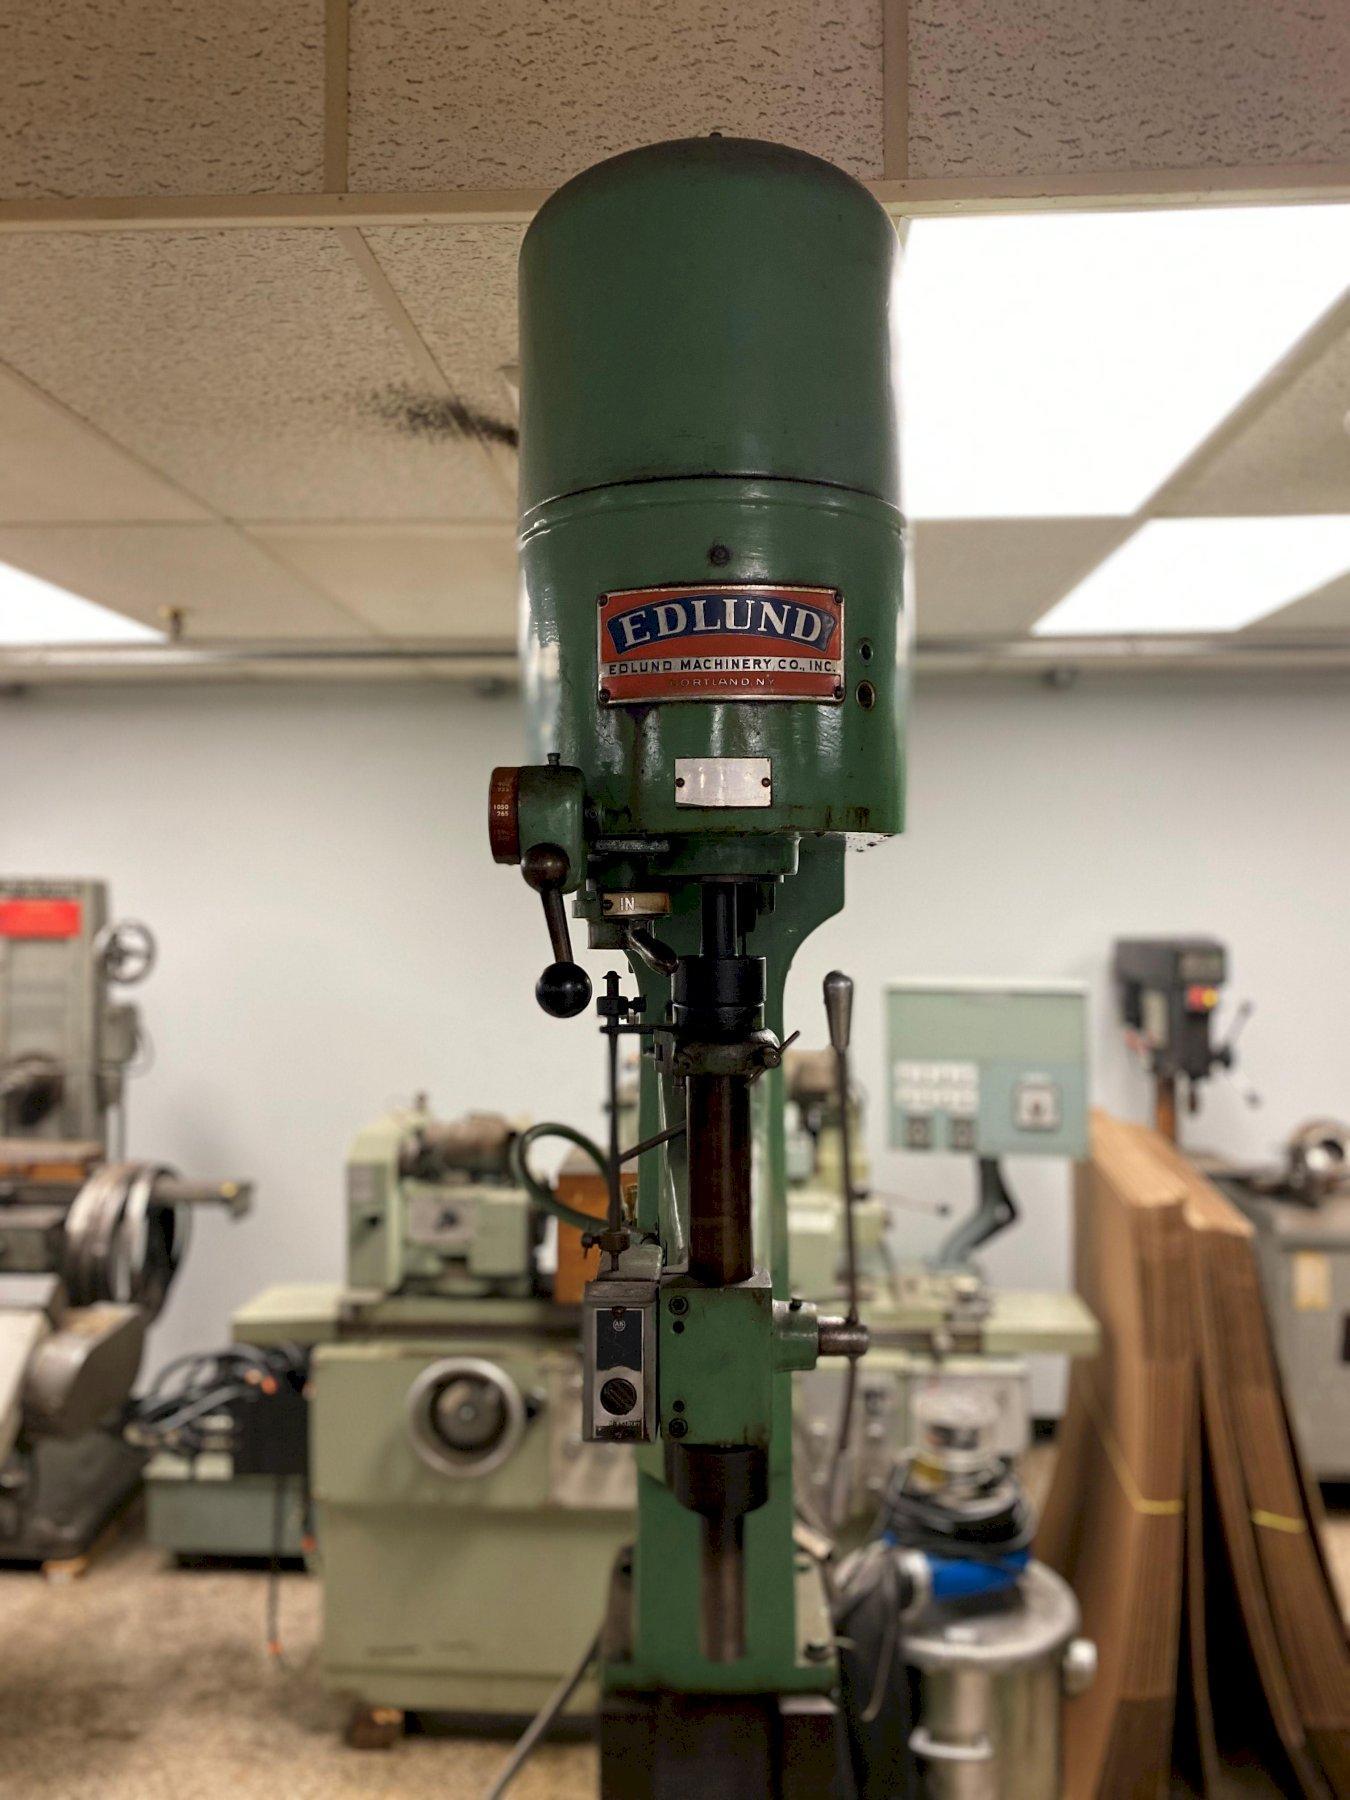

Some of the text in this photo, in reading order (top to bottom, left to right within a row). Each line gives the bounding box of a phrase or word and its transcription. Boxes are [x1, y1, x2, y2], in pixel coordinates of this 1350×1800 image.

[619, 599, 822, 648] EDLUND
[609, 661, 672, 675] EDLUND
[681, 658, 771, 671] MACHINERY
[809, 661, 836, 672] INC.
[620, 896, 635, 911] IN
